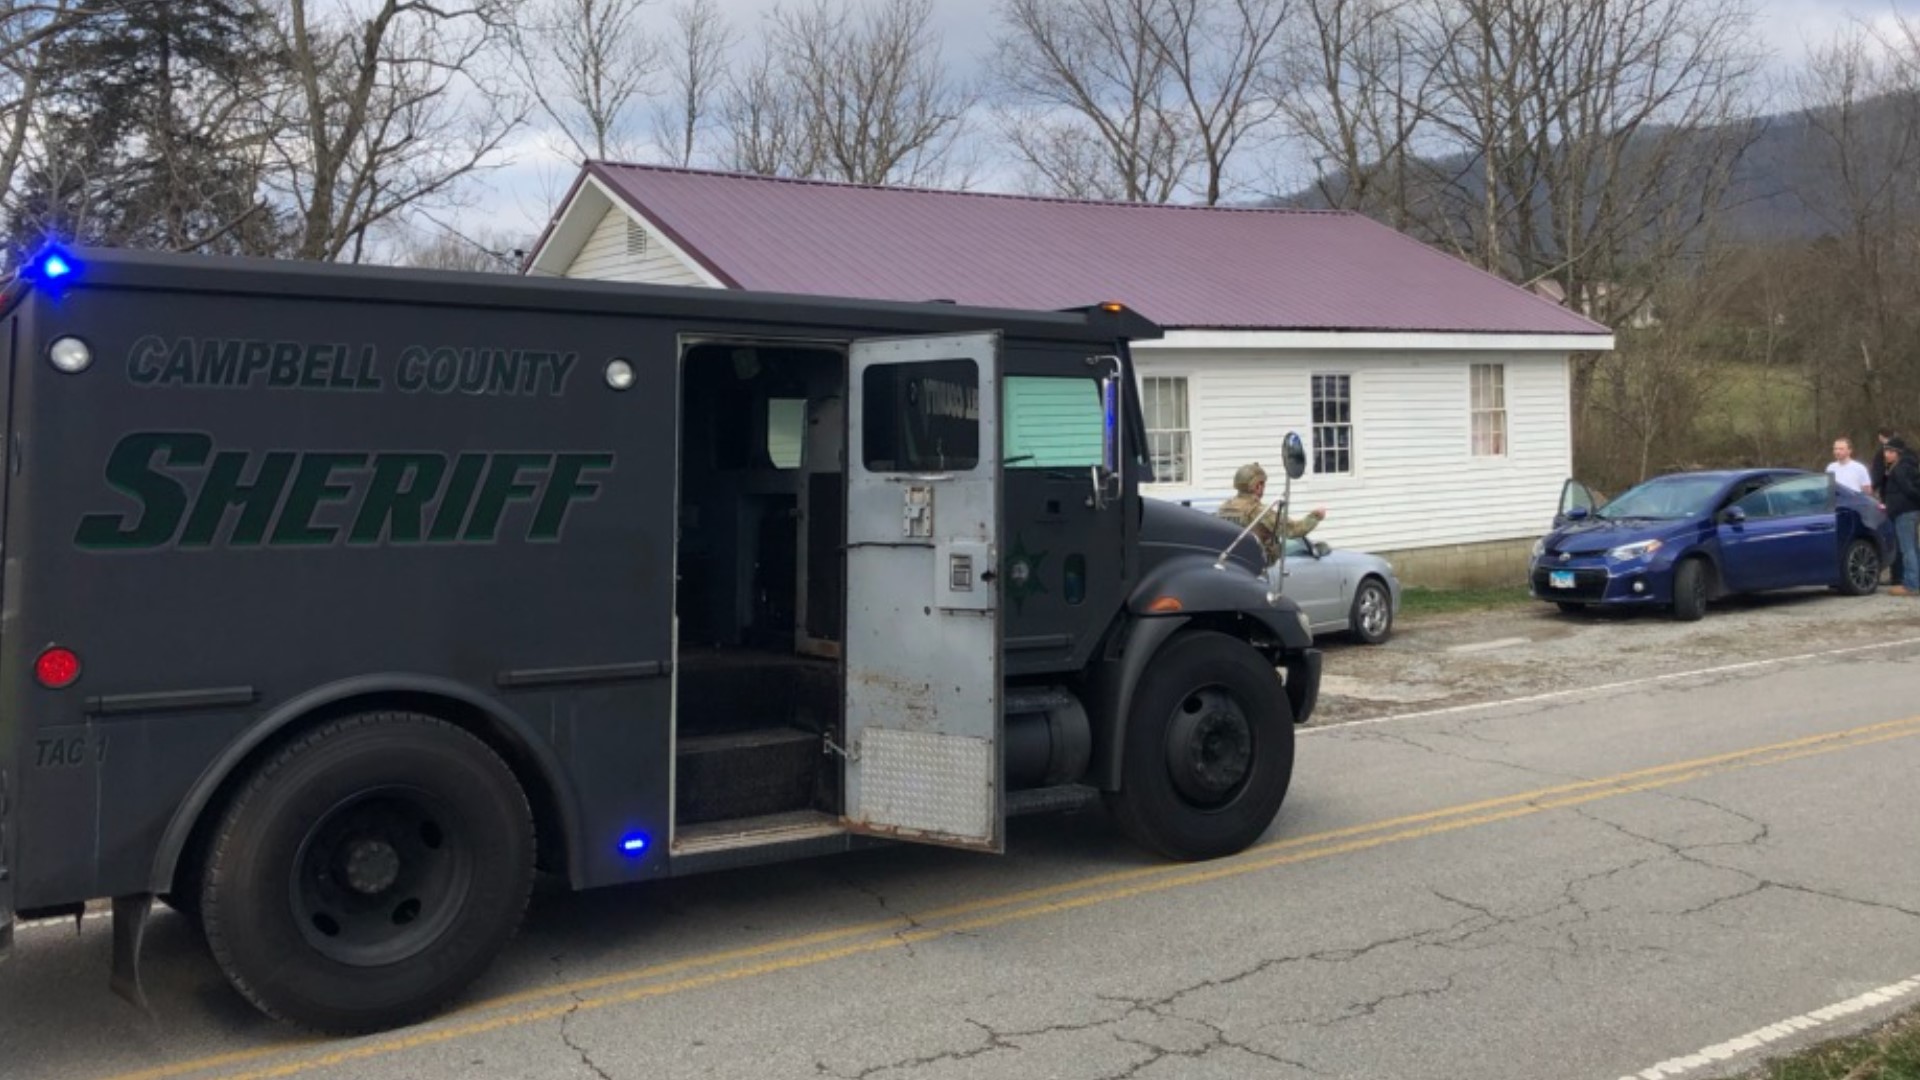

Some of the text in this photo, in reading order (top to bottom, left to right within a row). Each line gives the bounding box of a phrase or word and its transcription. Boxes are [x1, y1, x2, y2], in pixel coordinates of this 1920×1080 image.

[128, 335, 579, 396] CAMPBELL COUNTY
[73, 430, 616, 551] SHERIFF
[35, 737, 86, 767] TAC
